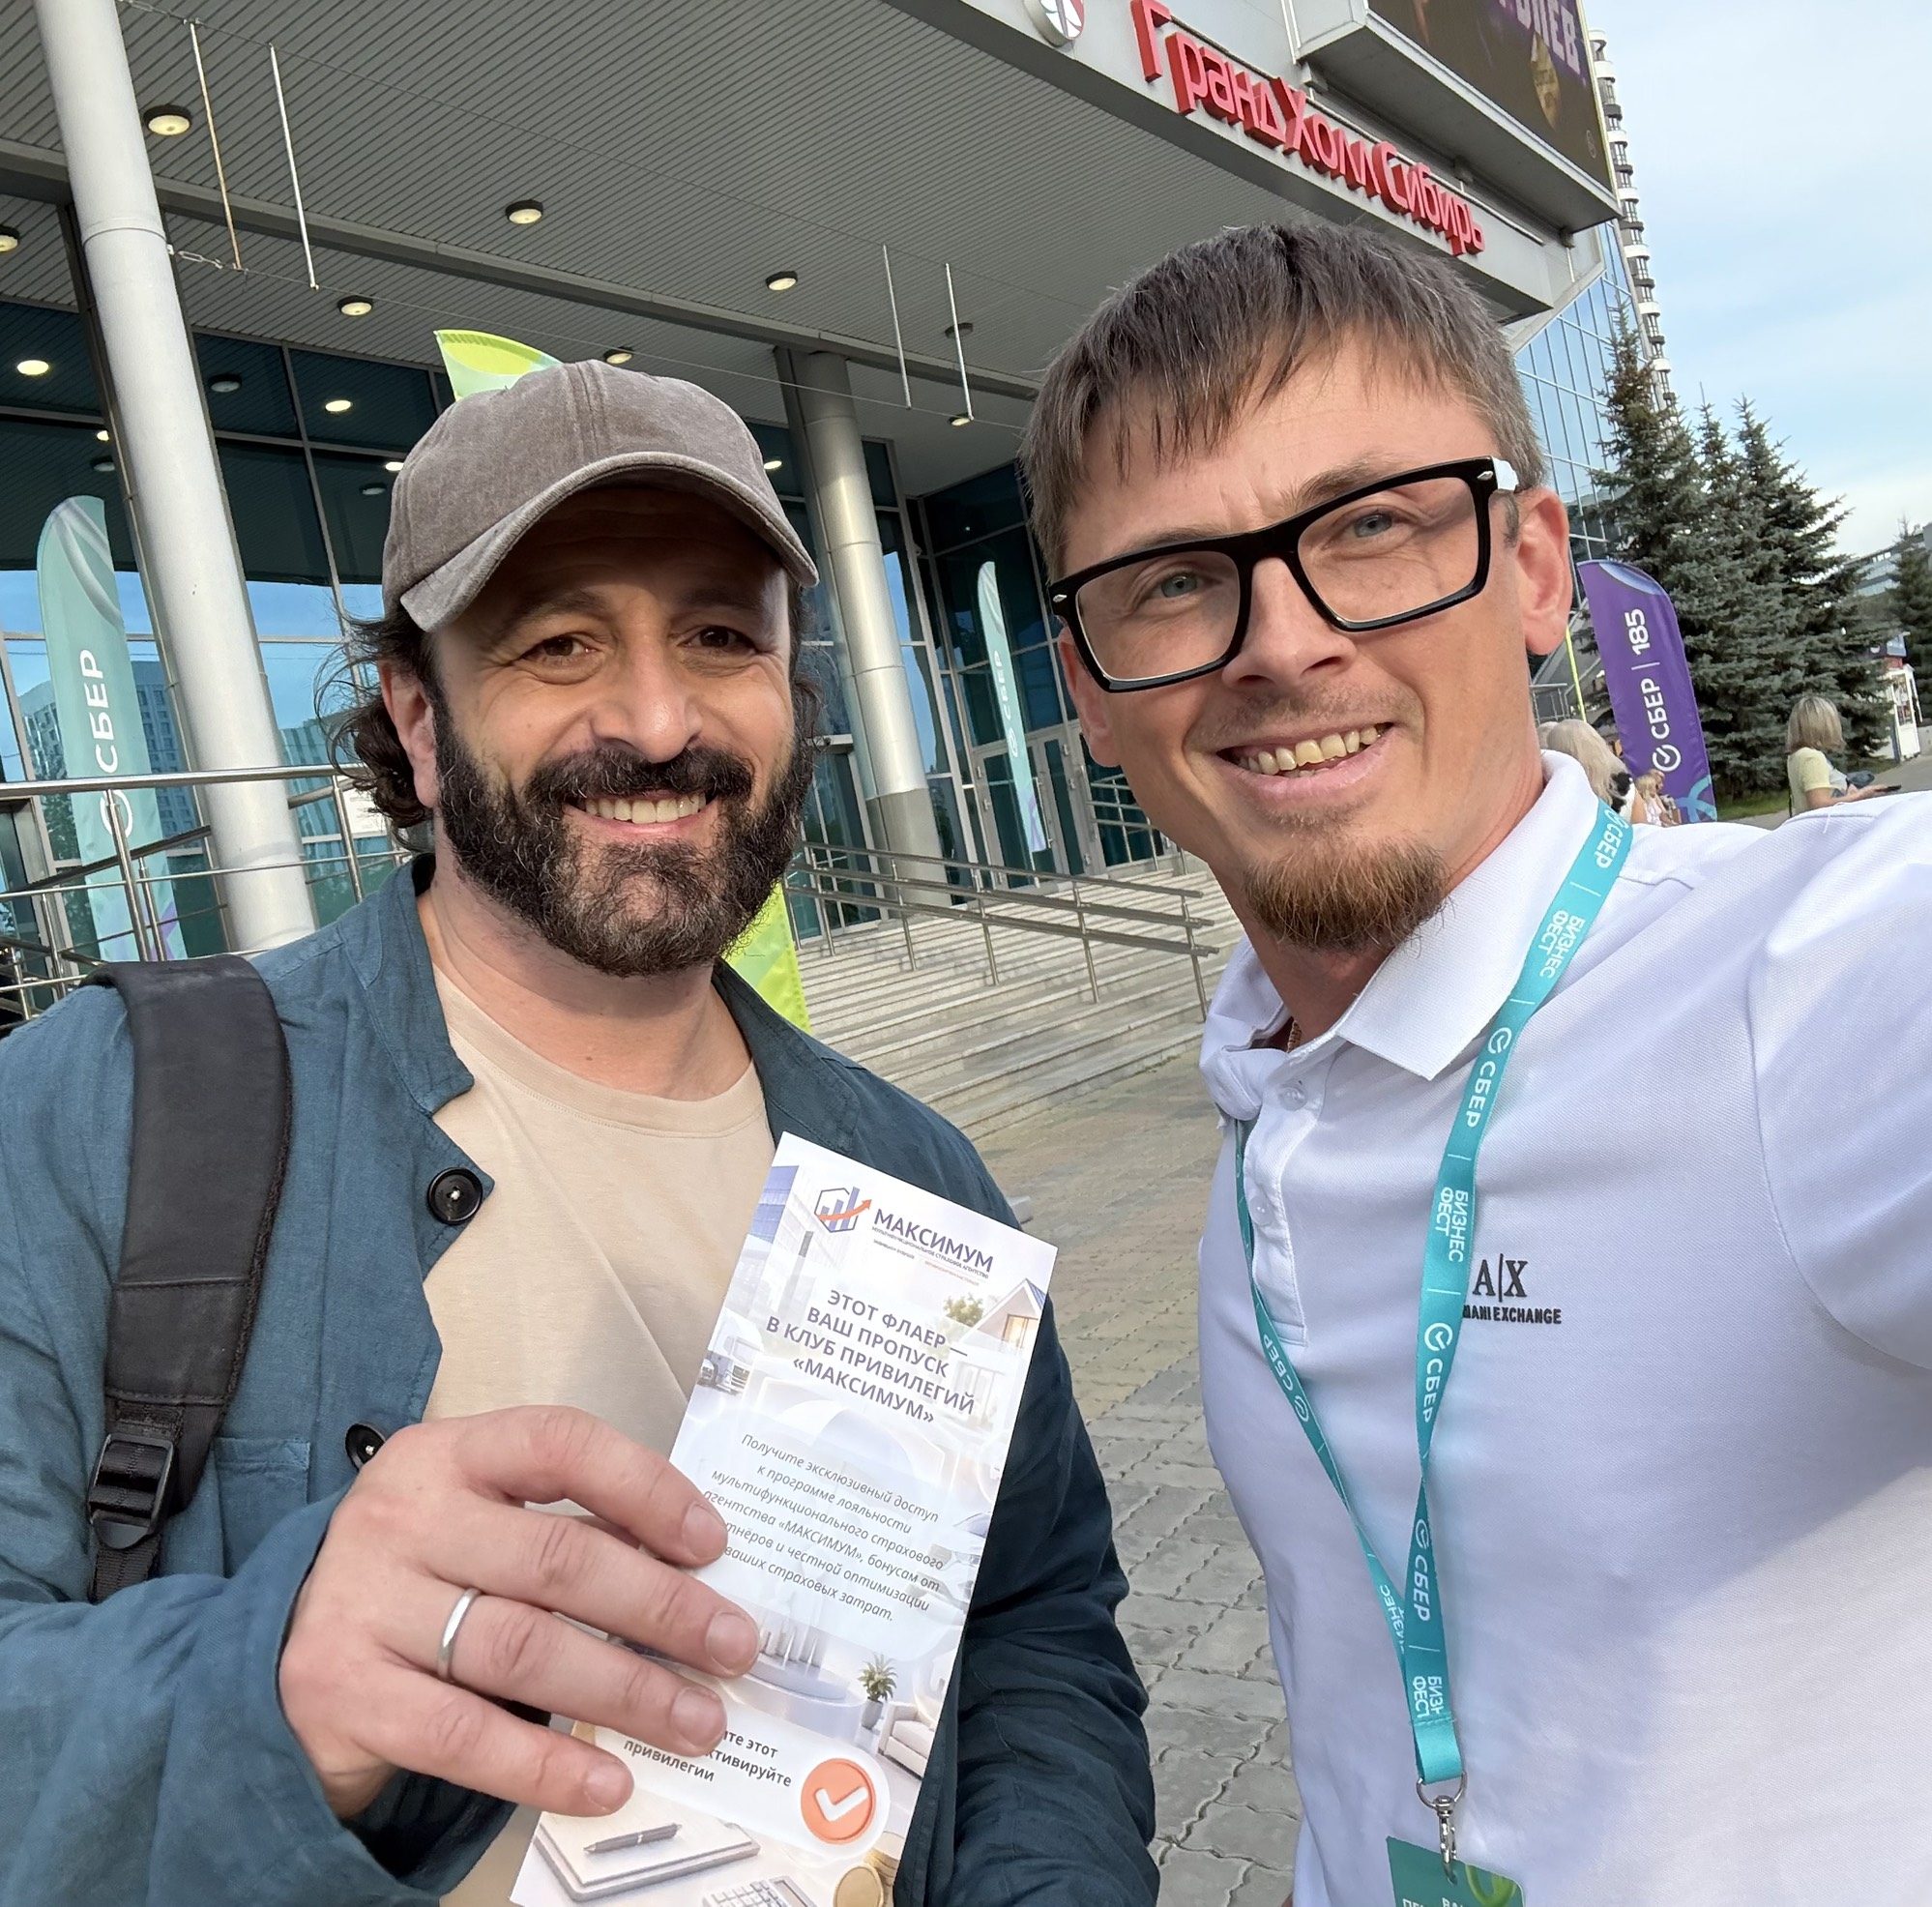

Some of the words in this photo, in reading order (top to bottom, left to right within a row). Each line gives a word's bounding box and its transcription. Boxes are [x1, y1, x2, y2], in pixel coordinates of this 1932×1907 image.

[1130, 0, 1286, 150] Гранд
[1372, 140, 1485, 256] Сибирь
[1625, 608, 1651, 656] 185
[79, 649, 119, 774] СБЕР
[1640, 677, 1670, 740] СБЕР
[1594, 824, 1624, 869] СБЕР
[1538, 910, 1567, 955] ФЕСТ
[1539, 916, 1586, 979] БИЗНЕС
[1466, 1061, 1496, 1128] СБЕР
[874, 1208, 993, 1273] МАКСИМУМ
[1435, 1187, 1453, 1236] ФЕСТ
[1449, 1189, 1469, 1262] БИЗНЕС
[807, 1306, 853, 1337] ВАШ
[858, 1328, 949, 1377] ПРОПУСК
[828, 1290, 878, 1320] ЭТОТ
[882, 1312, 946, 1348] ФЛАЕР
[1462, 1305, 1491, 1321] MANI
[1493, 1306, 1562, 1324] EXCHANGE
[766, 1316, 779, 1333] В
[784, 1323, 834, 1356] КЛУБ
[840, 1346, 975, 1415] ПРИВИЛЕГИЙ
[793, 1358, 934, 1423] «МАКСИМУМ»
[1263, 1334, 1294, 1392] СБЕР
[1422, 1358, 1443, 1423] СБЕР
[742, 1434, 804, 1468] Получите
[805, 1460, 892, 1504] эксклюзивный
[896, 1494, 939, 1523] доступ
[757, 1465, 764, 1475] к
[767, 1469, 835, 1503] программе
[837, 1497, 912, 1534] лояльности
[704, 1490, 776, 1525] агентства
[778, 1520, 864, 1564] «МАКСИМУМ»,
[867, 1554, 918, 1582] бонусам
[921, 1577, 940, 1592] от
[712, 1470, 868, 1540] мультифункционального
[870, 1533, 944, 1570] страхового
[725, 1546, 766, 1570] ваших
[768, 1563, 837, 1599] страховых
[840, 1592, 893, 1622] затрат.
[726, 1521, 774, 1548] тнёров
[776, 1543, 784, 1552] и
[787, 1547, 841, 1575] честной
[843, 1570, 929, 1611] оптимизации
[1414, 1554, 1430, 1622] СБЕР
[623, 1740, 715, 1782] привилегии
[705, 1748, 792, 1787] ктивируйте
[746, 1739, 778, 1758] этот
